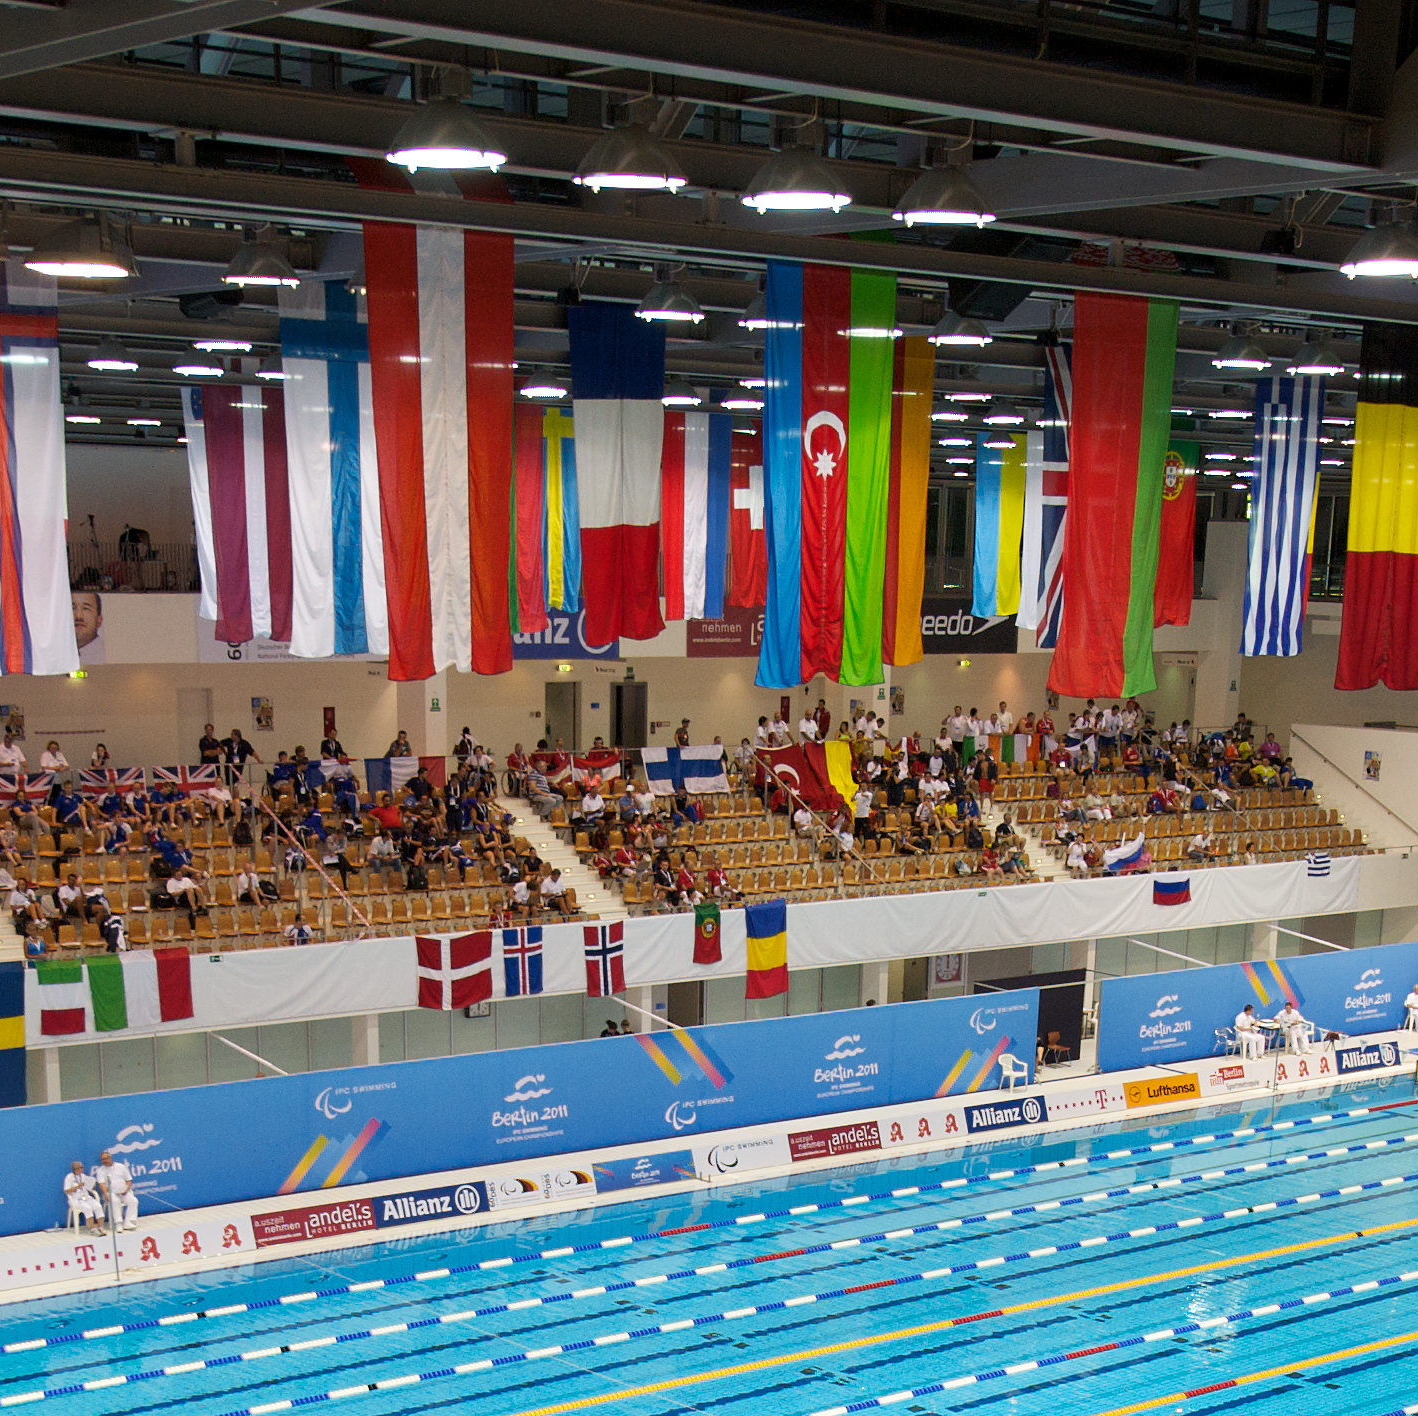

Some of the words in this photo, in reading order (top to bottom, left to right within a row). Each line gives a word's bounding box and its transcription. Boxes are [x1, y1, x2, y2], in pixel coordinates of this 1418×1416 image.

[921, 609, 974, 636] eedo
[855, 1062, 880, 1077] 2011
[1341, 1050, 1380, 1070] Allianz
[1146, 1083, 1196, 1098] Lufthansa
[540, 1104, 569, 1120] 2011
[971, 1107, 1021, 1128] Allianz
[148, 1156, 183, 1175] 2011
[383, 1196, 453, 1221] Allianz
